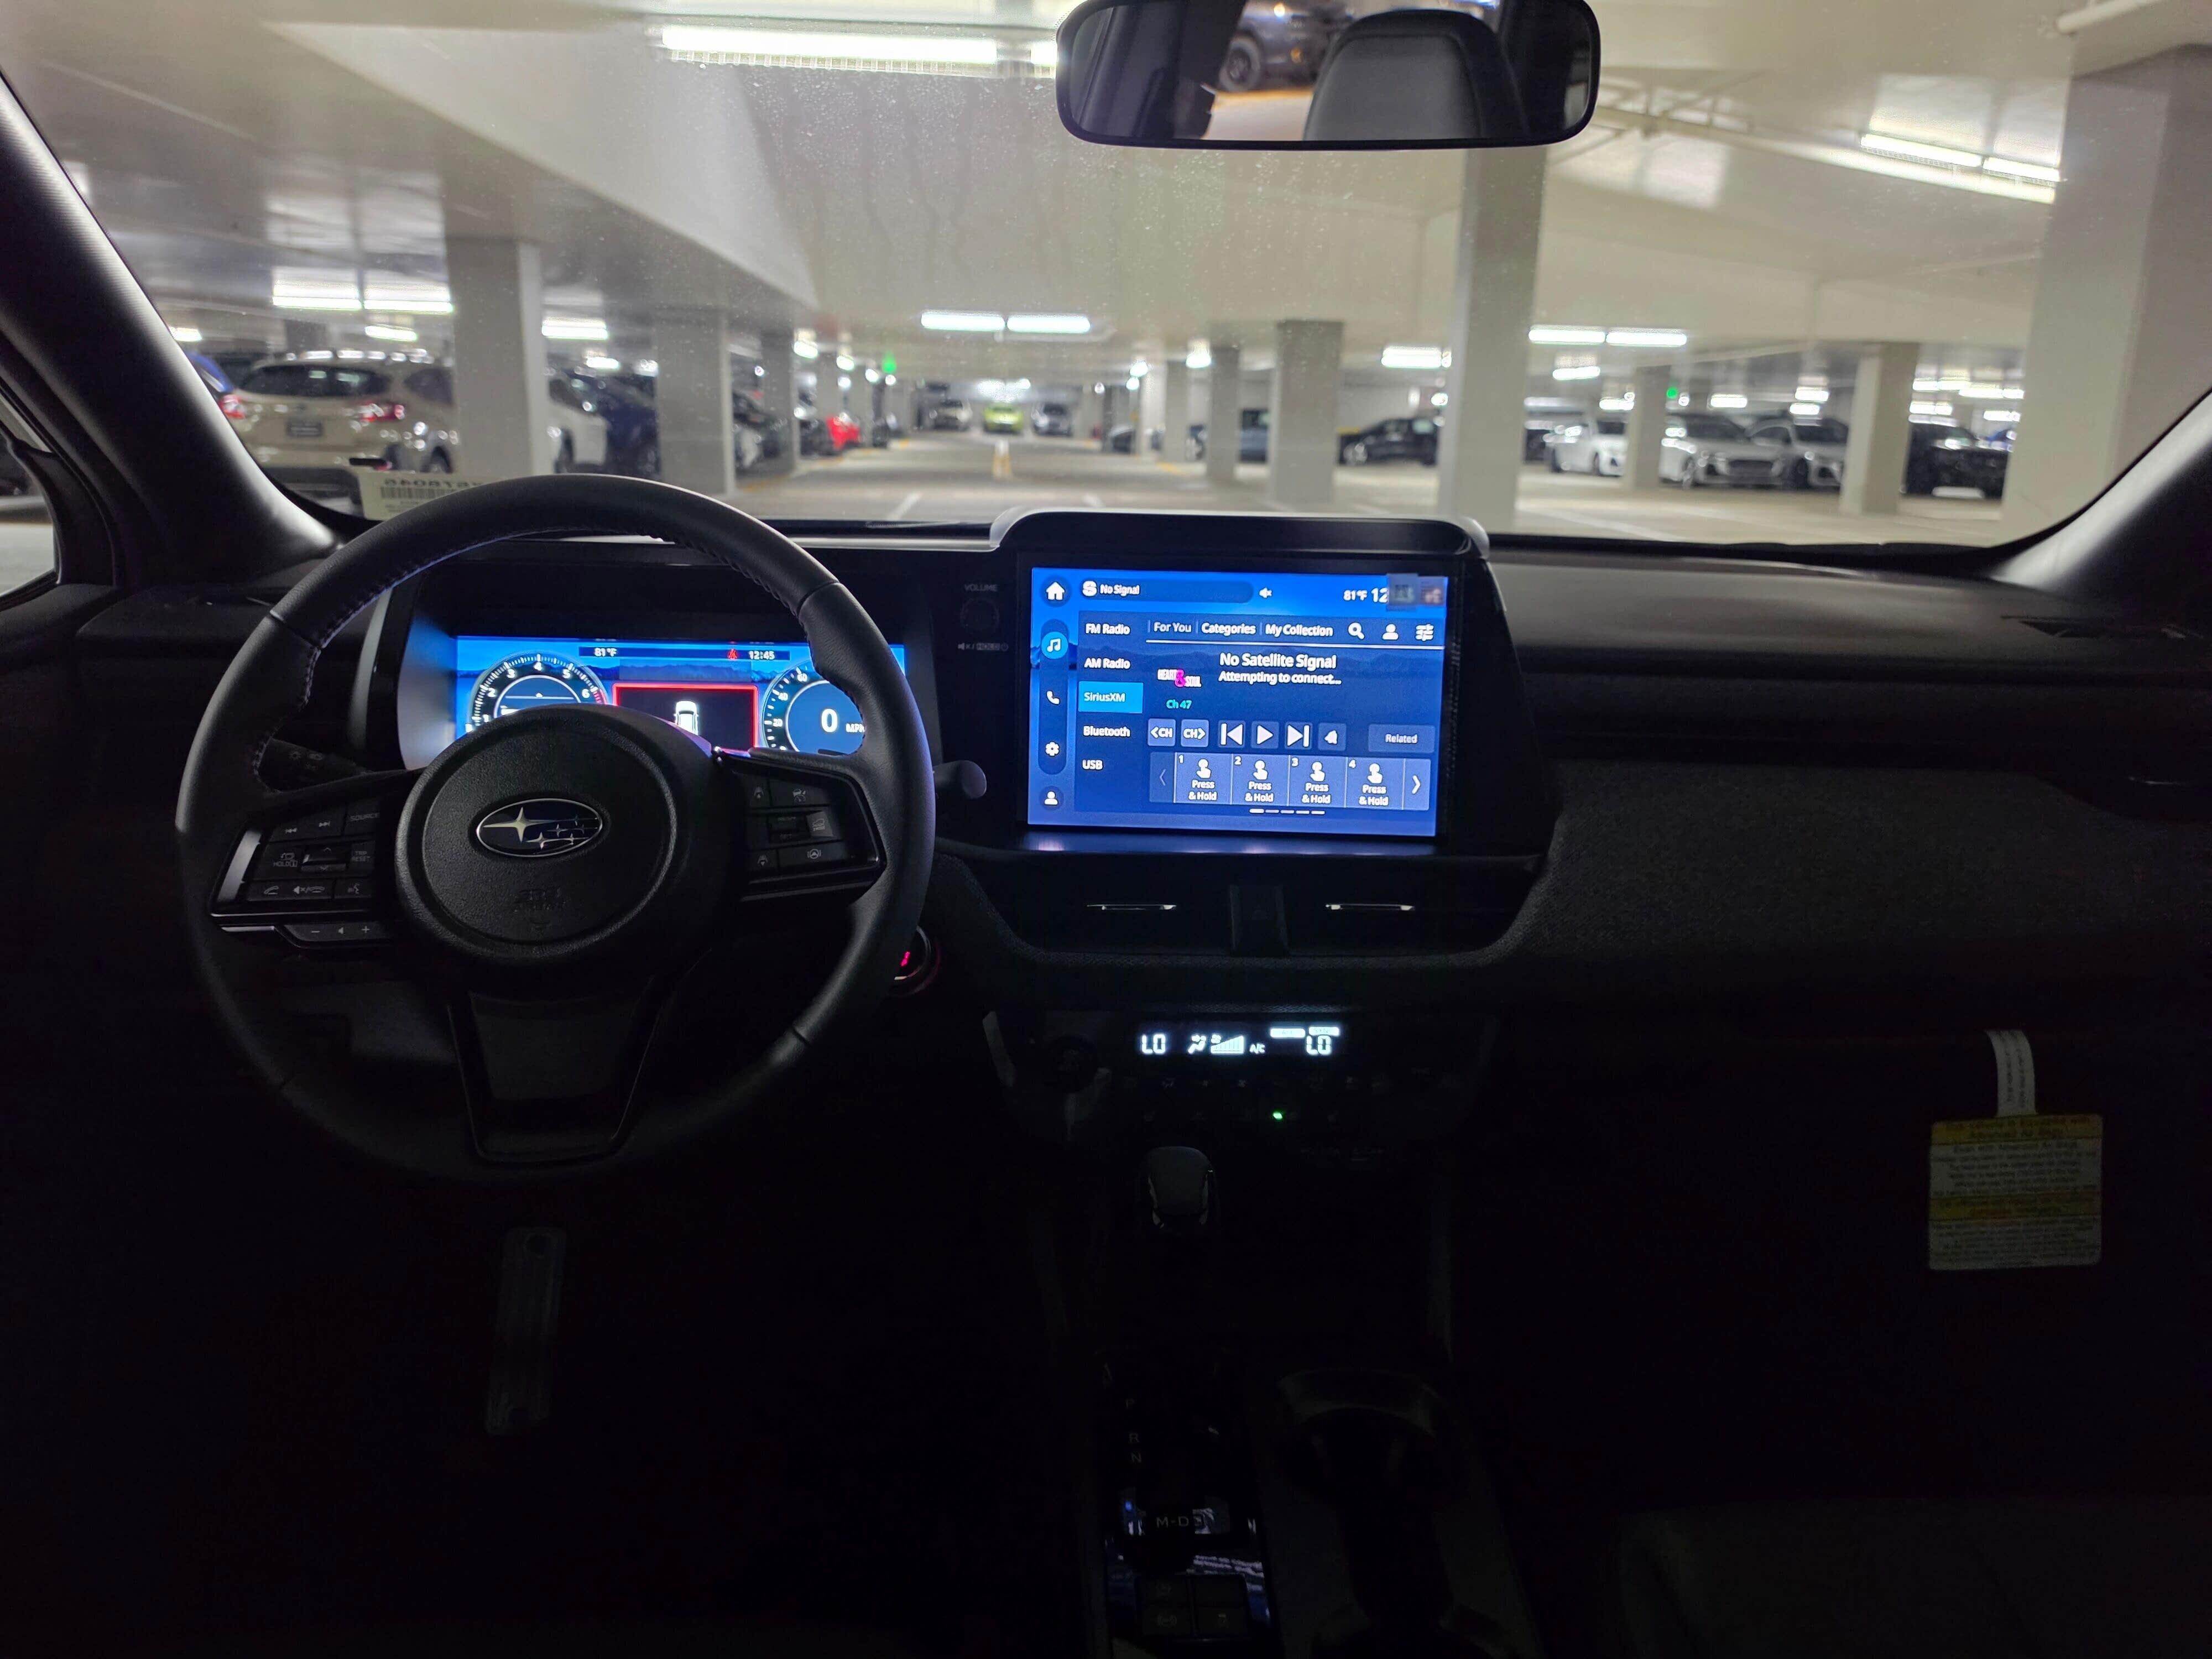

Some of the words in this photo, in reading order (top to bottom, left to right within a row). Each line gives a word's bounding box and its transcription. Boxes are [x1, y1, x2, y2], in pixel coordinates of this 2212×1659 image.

[1100, 584, 1113, 594] No
[1114, 585, 1140, 597] Signal
[1085, 623, 1101, 634] FM
[1102, 623, 1130, 635] Radio
[1154, 622, 1171, 632] For
[1173, 622, 1192, 633] You
[1201, 623, 1256, 637] Categories
[1265, 624, 1283, 637] My
[1283, 624, 1333, 637] Collection
[749, 650, 775, 660] 12:45
[534, 662, 543, 671] 4
[1084, 658, 1102, 668] AM
[1103, 658, 1131, 669] Radio
[1219, 653, 1240, 666] No
[1241, 653, 1294, 668] Satellite
[1295, 654, 1337, 671] Signal
[507, 669, 516, 679] 3
[562, 669, 571, 679] 5
[797, 673, 808, 682] 60
[1219, 671, 1277, 685] Attempting
[1279, 672, 1291, 684] to
[487, 688, 496, 697] 2
[582, 689, 590, 698] 6
[778, 692, 789, 701] 40
[1083, 692, 1125, 702] SiriusXM
[1166, 700, 1179, 709] Ch
[1180, 700, 1192, 709] 47
[773, 718, 783, 727] 20
[821, 708, 838, 733] 0
[1083, 726, 1131, 737] Bluetooth
[1385, 733, 1418, 744] Related
[1178, 754, 1184, 764] 1
[1234, 756, 1241, 765] 2
[1291, 757, 1298, 767] 3
[1348, 759, 1356, 768] 4
[1082, 760, 1103, 770] USB
[1192, 780, 1215, 789] Press
[1248, 781, 1271, 791] Press
[1305, 782, 1329, 792] Press
[1362, 785, 1386, 795] Press
[1188, 792, 1196, 801] &
[1197, 792, 1217, 801] Hold
[1245, 793, 1253, 802] &
[1254, 793, 1274, 803] Hold
[1302, 794, 1310, 804] &
[1310, 794, 1331, 804] Hold
[1359, 796, 1367, 805] &
[1368, 796, 1389, 806] Hold
